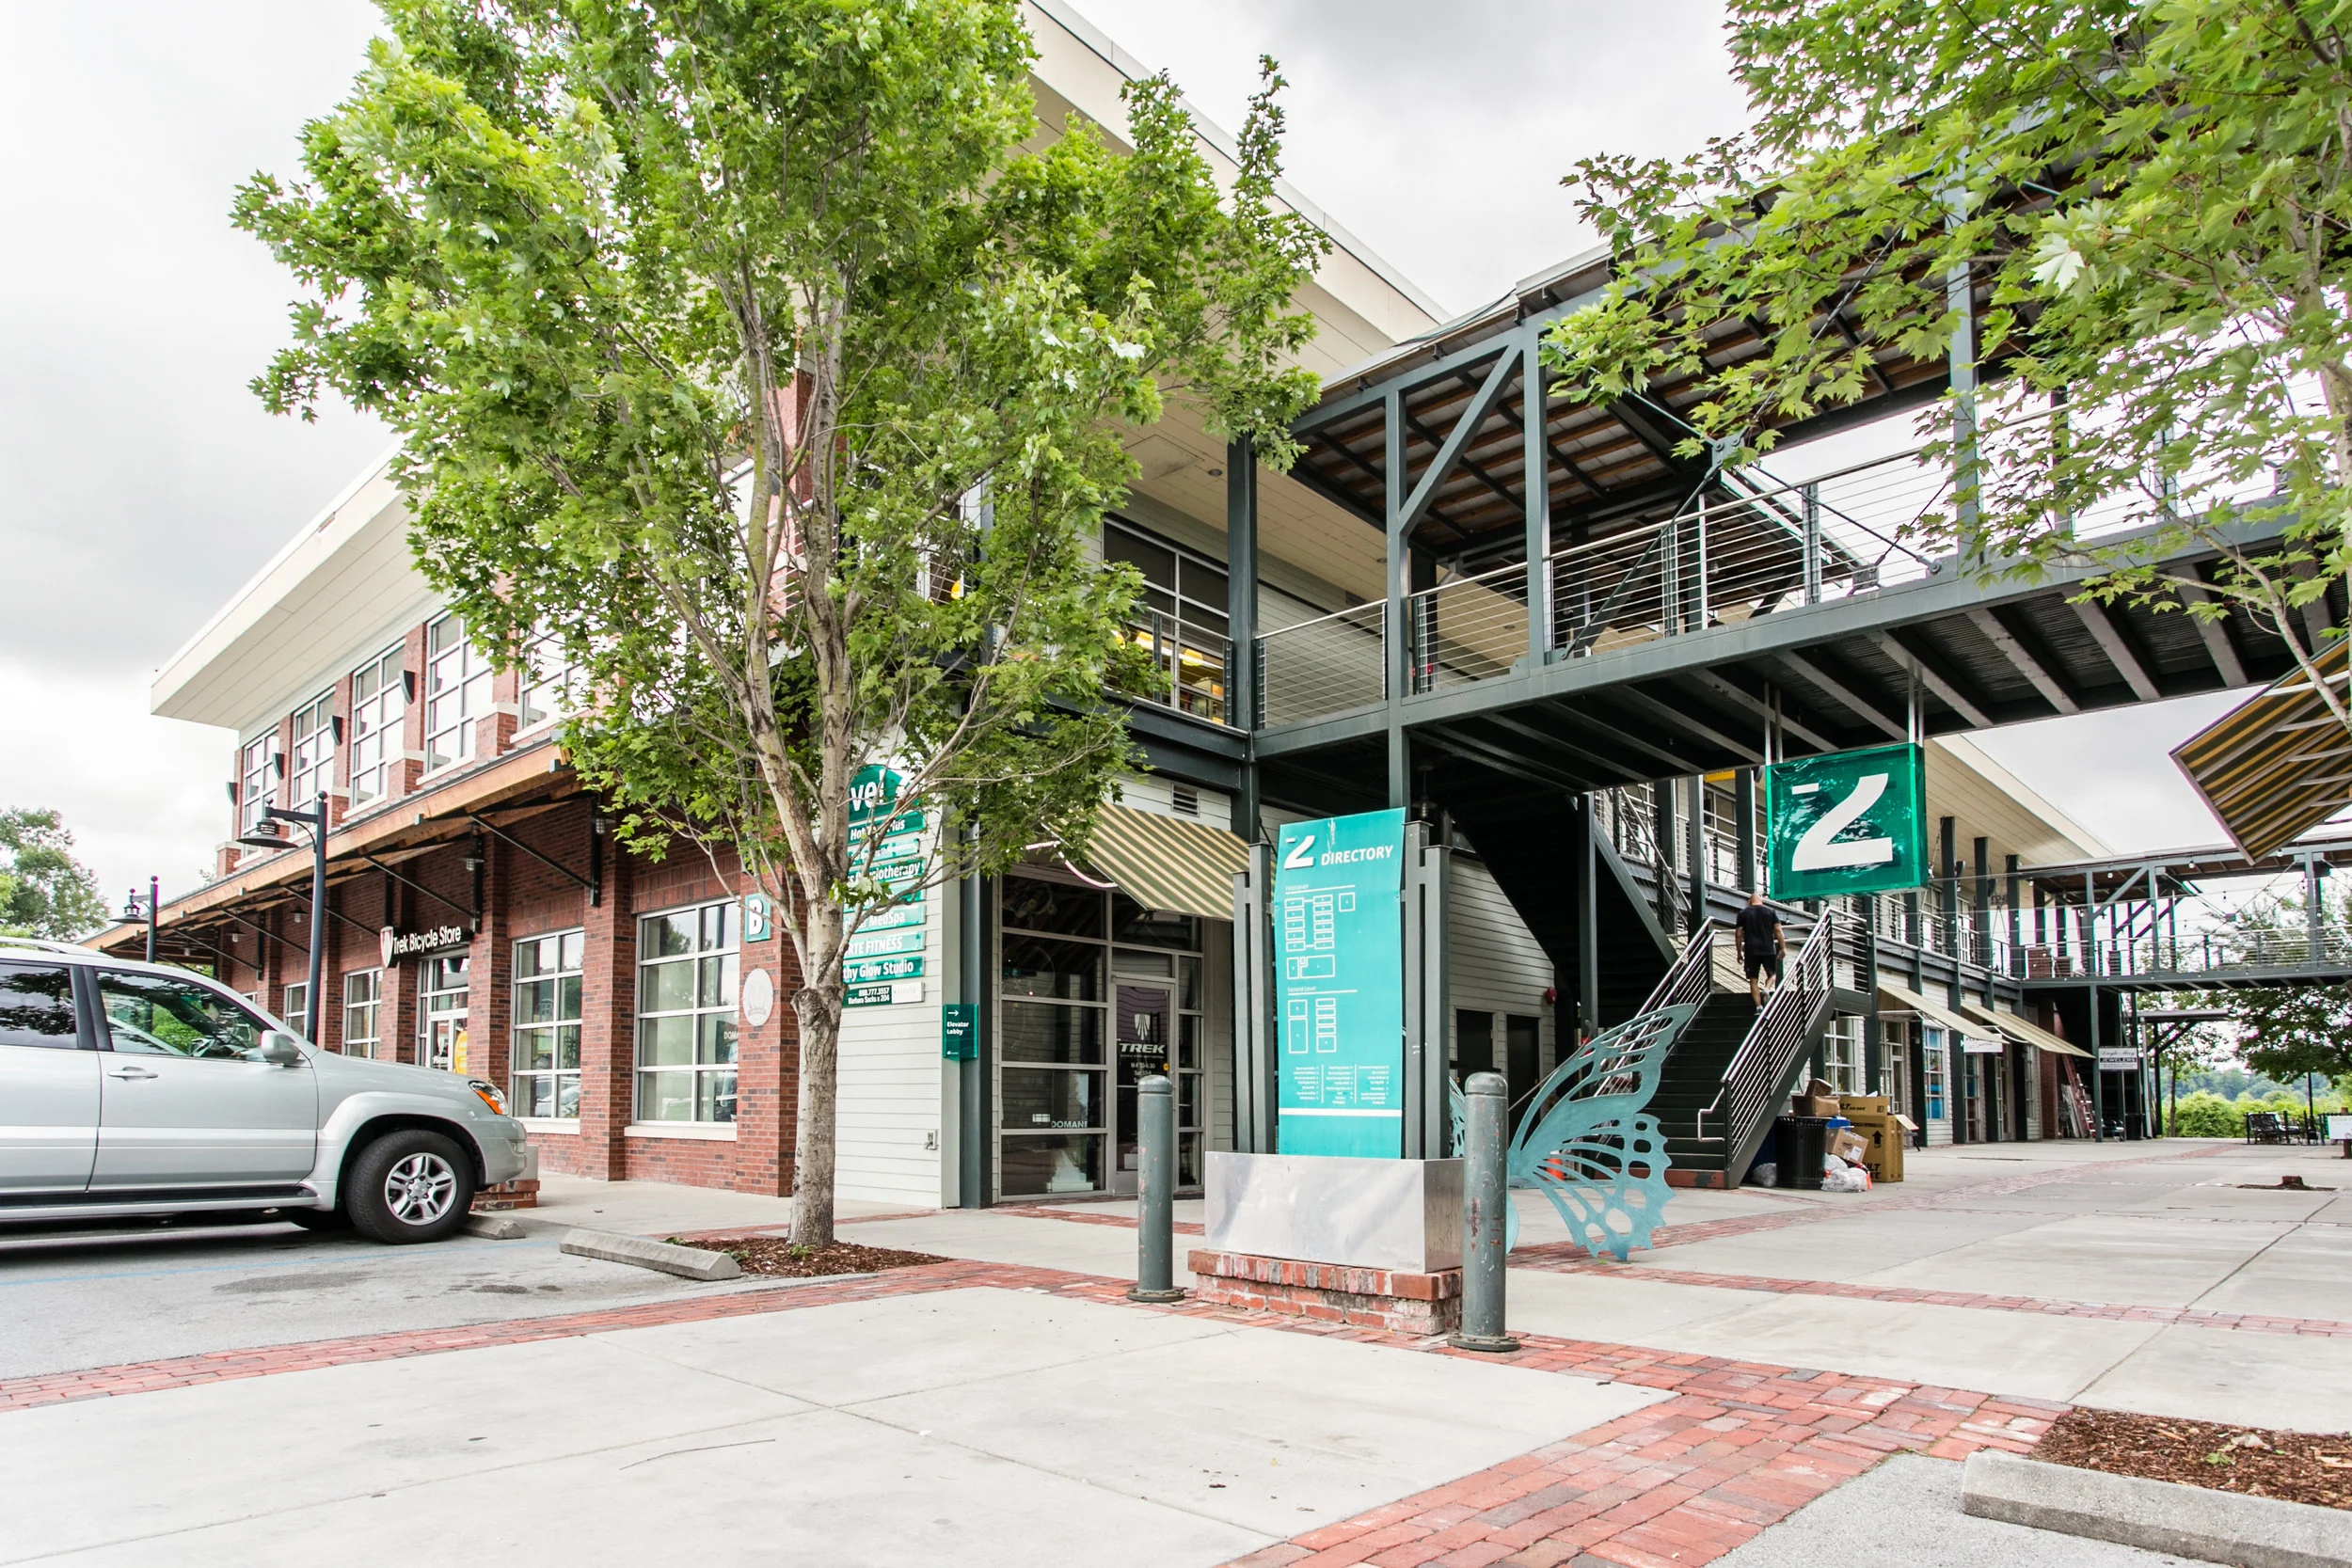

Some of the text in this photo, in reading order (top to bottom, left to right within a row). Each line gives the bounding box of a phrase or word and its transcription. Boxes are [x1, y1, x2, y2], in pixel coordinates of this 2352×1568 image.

[850, 768, 884, 812] ve!
[1322, 846, 1393, 865] DIRECTORY
[749, 899, 763, 935] B
[393, 927, 461, 954] Trek Bicycle Store
[866, 936, 902, 953] FITNESS
[859, 961, 882, 976] Glow
[882, 958, 914, 975] Studio
[1120, 1043, 1166, 1053] TREK
